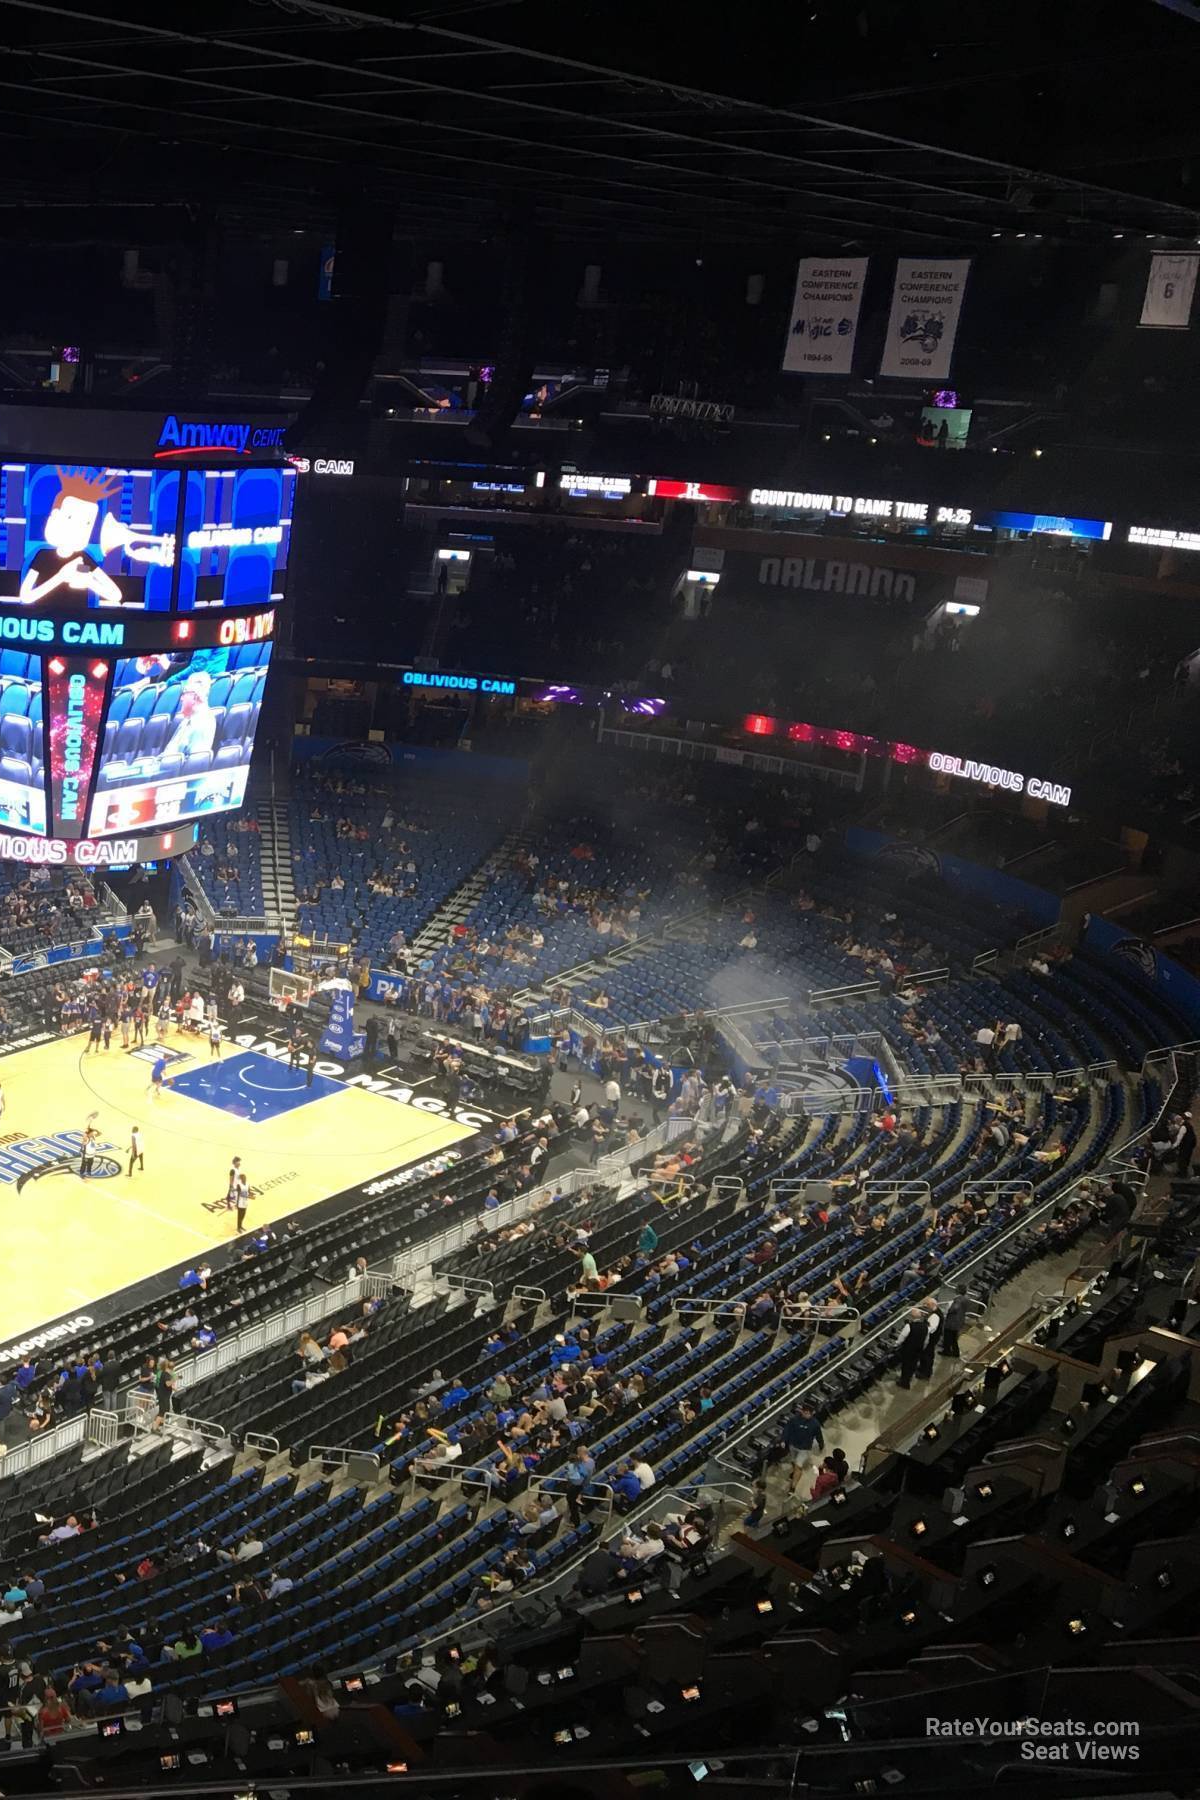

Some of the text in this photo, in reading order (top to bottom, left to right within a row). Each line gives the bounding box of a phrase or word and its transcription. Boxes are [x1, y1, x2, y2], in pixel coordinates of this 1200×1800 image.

[812, 269, 852, 277] EASTERN
[911, 271, 953, 279] EASTERN
[801, 281, 859, 290] CONFERENCE
[900, 283, 959, 292] CONFERENCE
[1164, 283, 1174, 299] 6
[803, 293, 854, 301] CHAMPIONS
[901, 295, 953, 304] CHAMPIONS
[158, 415, 250, 453] Amway
[314, 458, 354, 475] CAM
[750, 488, 833, 511] COUNTDOWN
[836, 496, 852, 512] TO
[855, 498, 893, 517] GAME
[896, 502, 929, 521] TIME
[62, 619, 124, 646] CAM
[403, 672, 515, 695] OBLIVIOUS CAM
[60, 673, 86, 821] OBLIVIOUS CAM
[929, 752, 1072, 806] OBLIVIOUS CAM
[74, 839, 138, 864] CAM
[259, 1171, 300, 1193] CENTER
